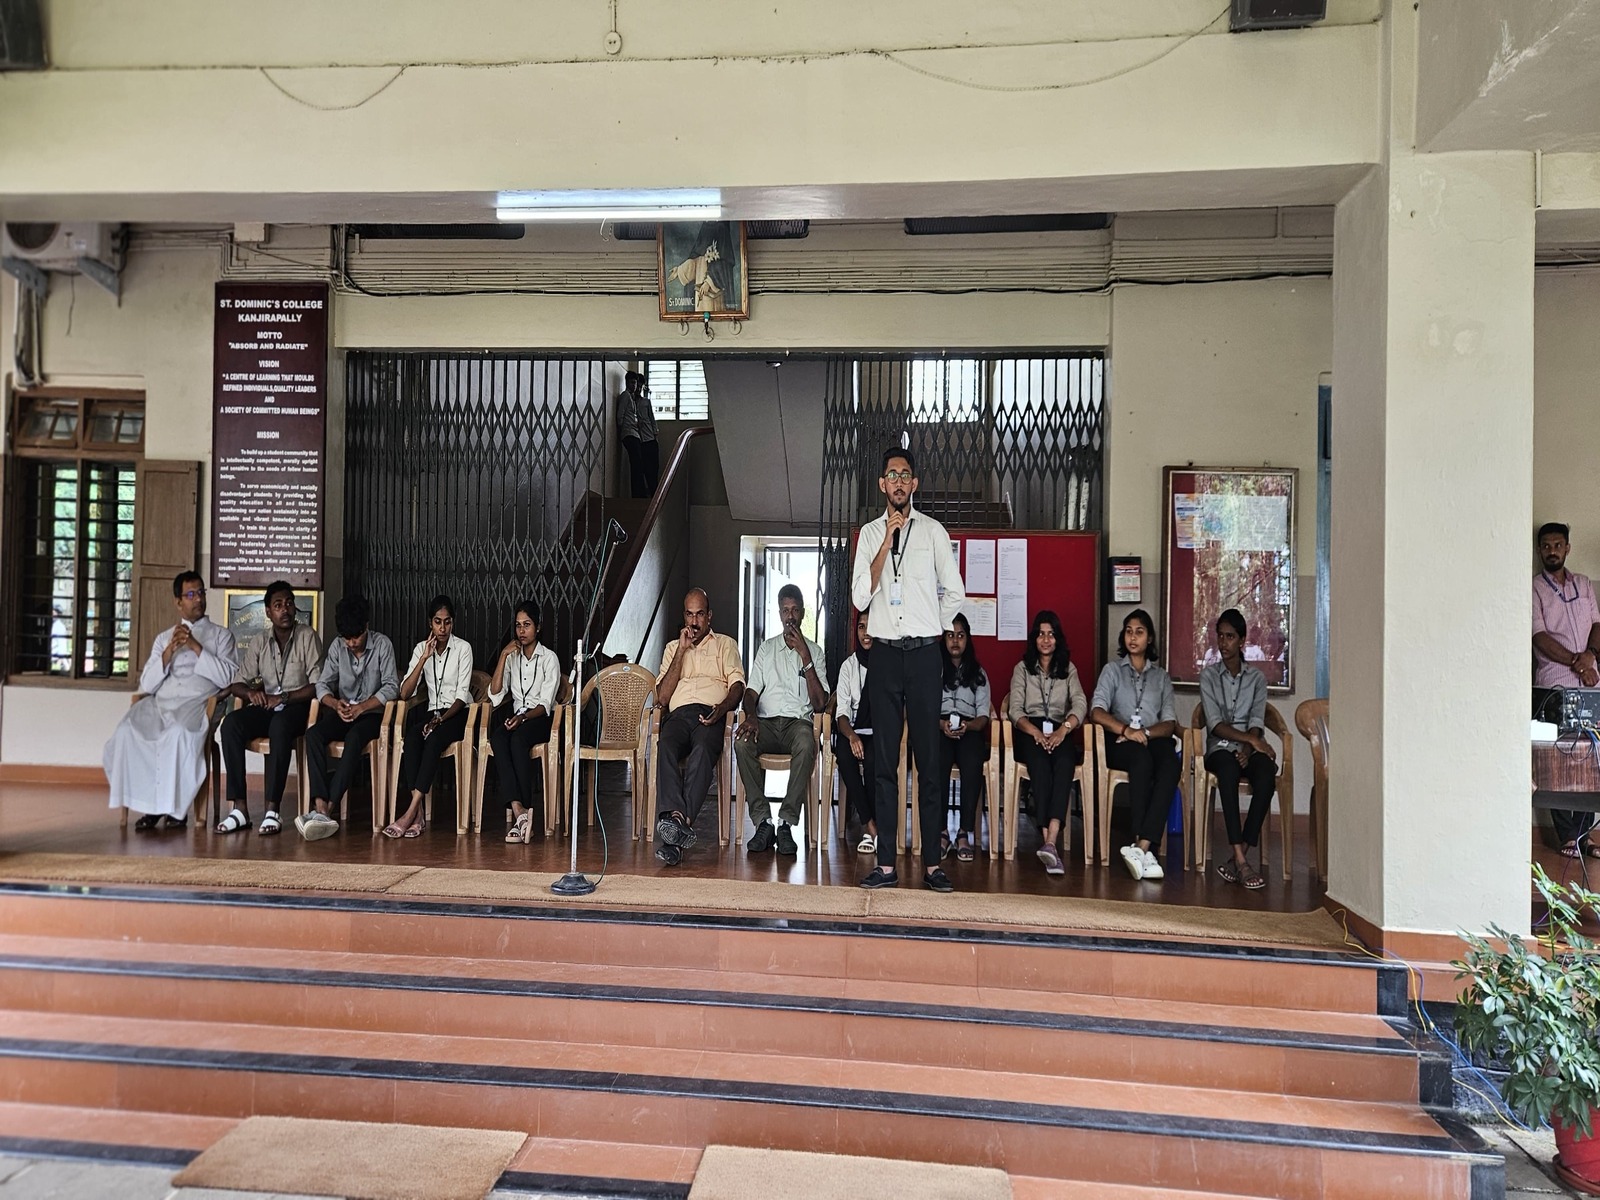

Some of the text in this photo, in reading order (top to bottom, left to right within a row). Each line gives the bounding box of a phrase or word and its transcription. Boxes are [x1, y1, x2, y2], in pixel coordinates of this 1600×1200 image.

[220, 300, 322, 309] ST. DOMINIC'S COLLEGE
[675, 298, 694, 306] DOMINIC
[238, 314, 302, 322] KANJIRAPALLY
